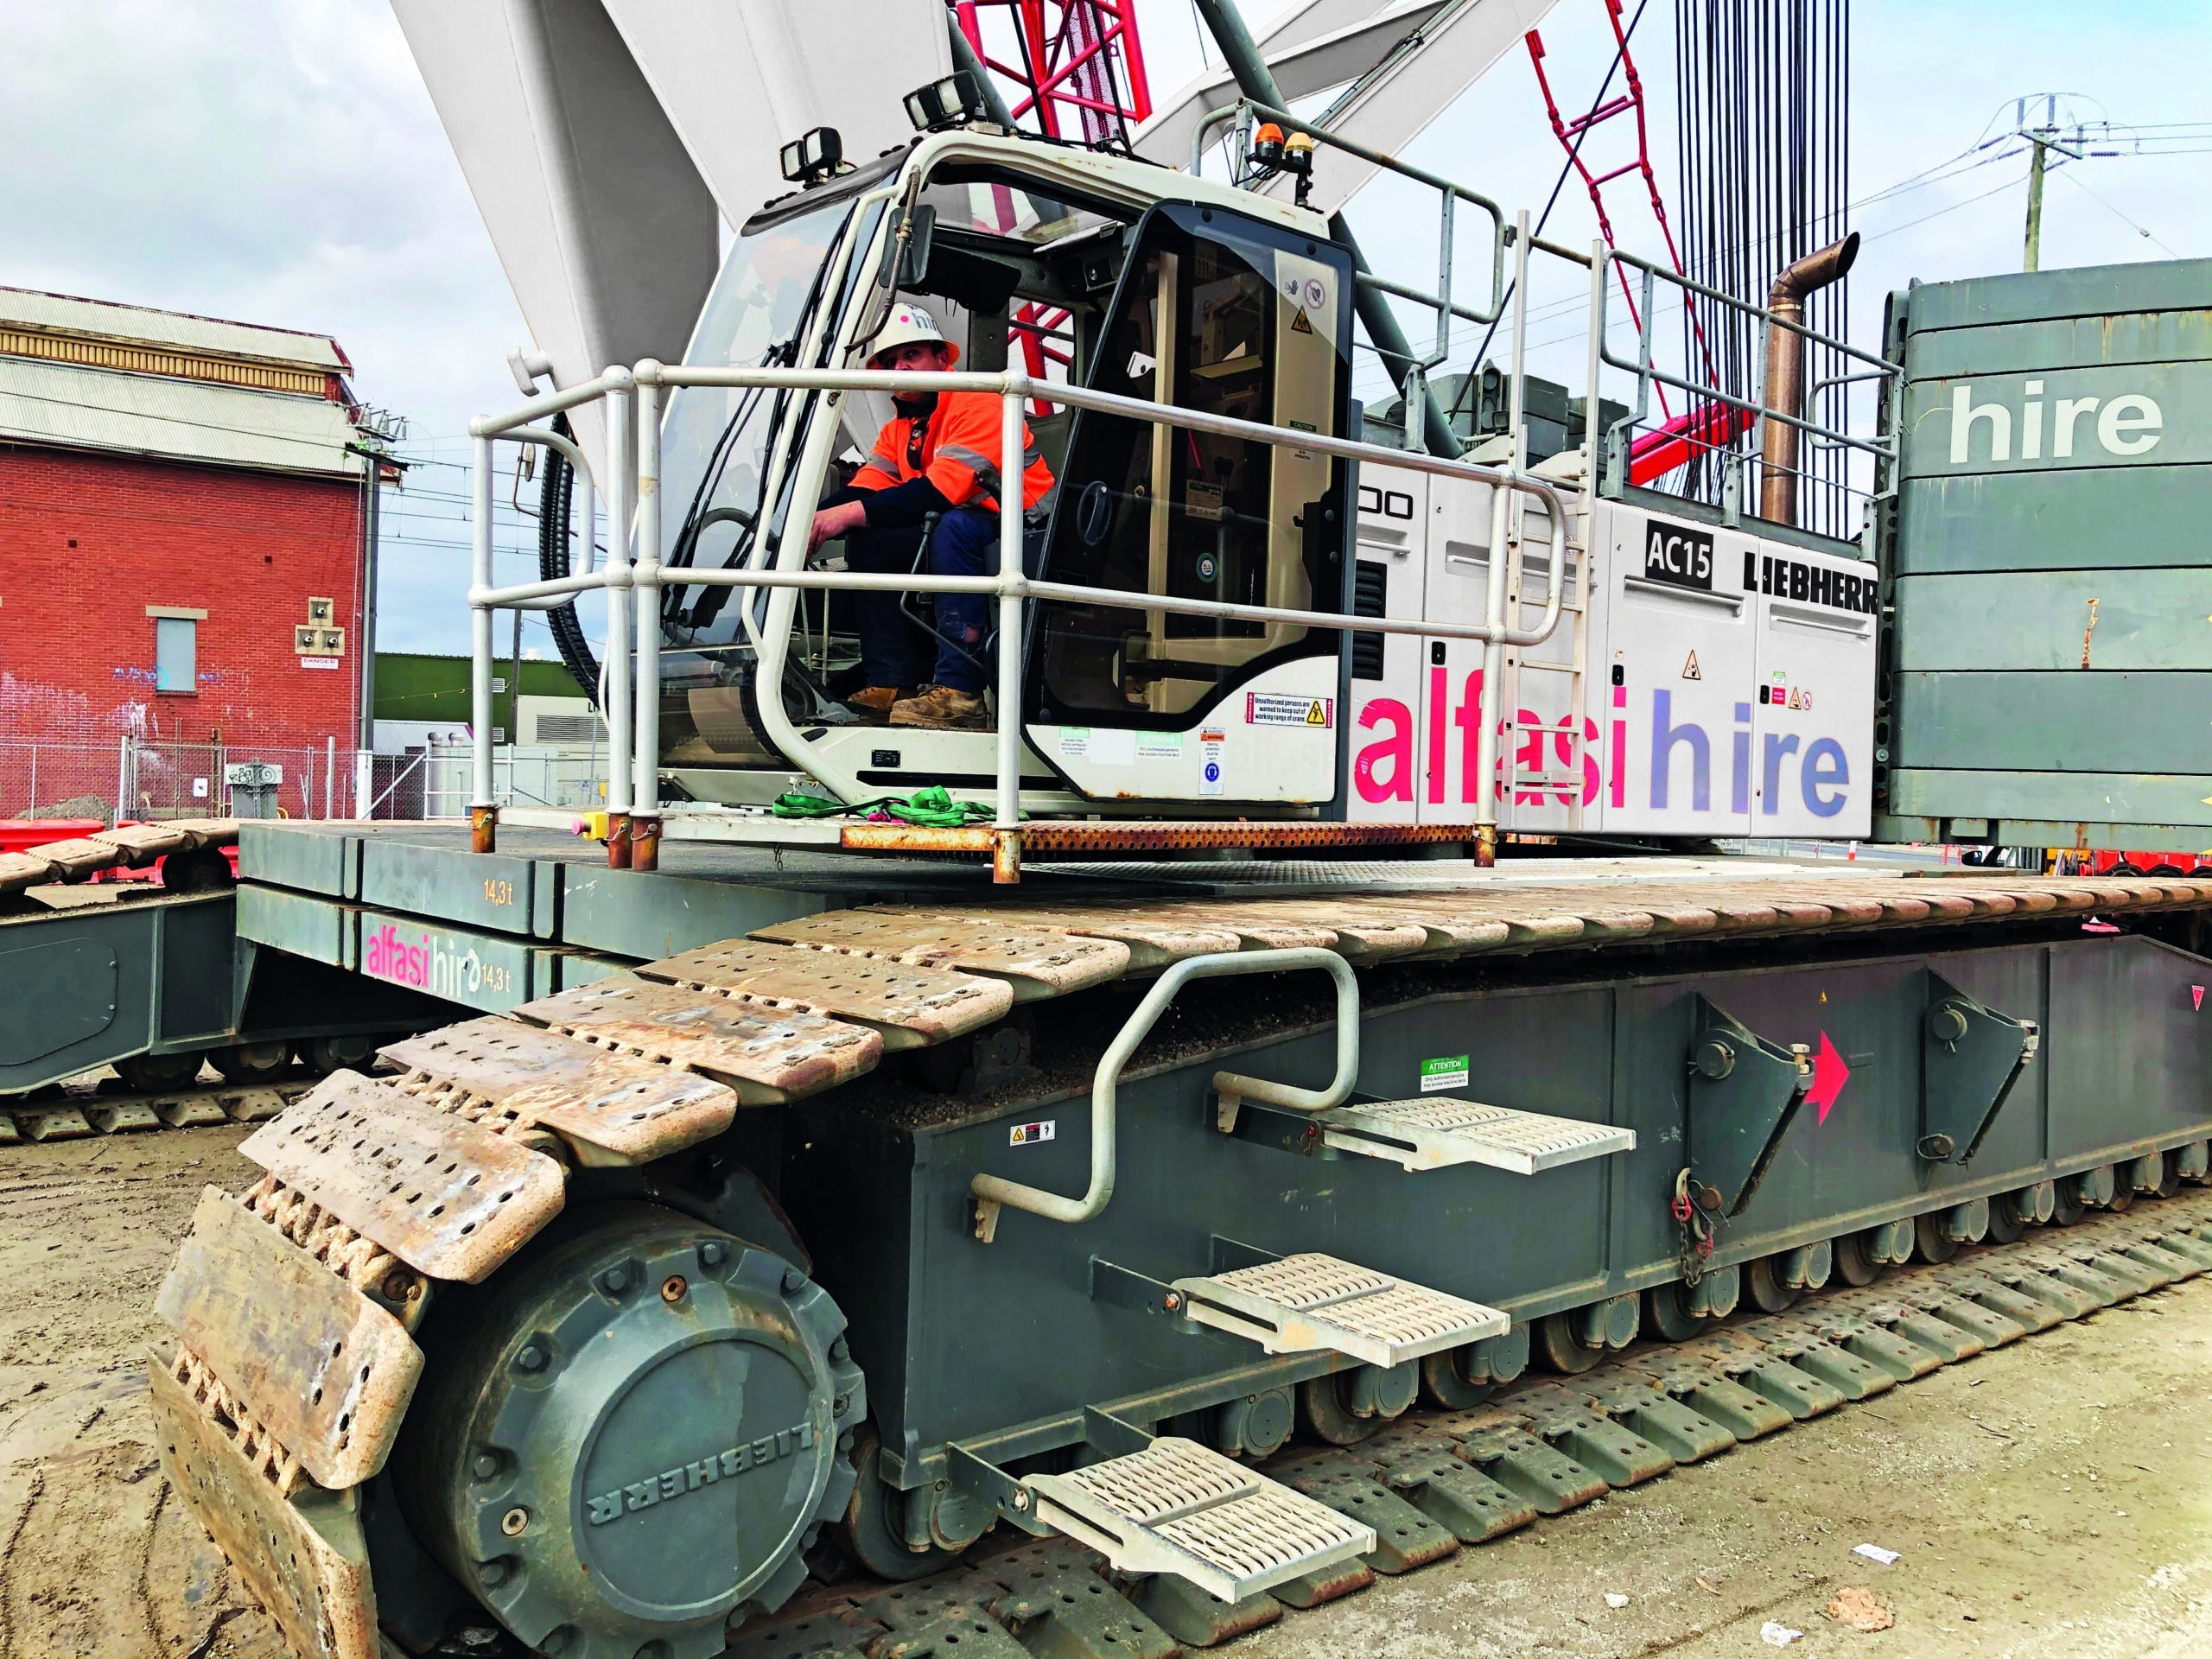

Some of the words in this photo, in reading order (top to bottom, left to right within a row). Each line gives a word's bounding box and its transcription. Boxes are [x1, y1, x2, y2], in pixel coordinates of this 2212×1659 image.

[1294, 422, 1313, 430] CAUTION
[1950, 379, 2163, 464] hire
[1647, 531, 1711, 579] AC15
[1743, 550, 1878, 615] LIEBHERR
[1255, 697, 1285, 706] Unauthorized
[1354, 667, 1626, 807] alfasi
[1649, 688, 1850, 817] hire
[483, 878, 506, 907] 14,3
[367, 923, 429, 988] alfasi
[481, 963, 504, 993] 14,3
[1428, 1059, 1462, 1071] ATTENTION
[586, 1421, 814, 1527] LIEBHERR
